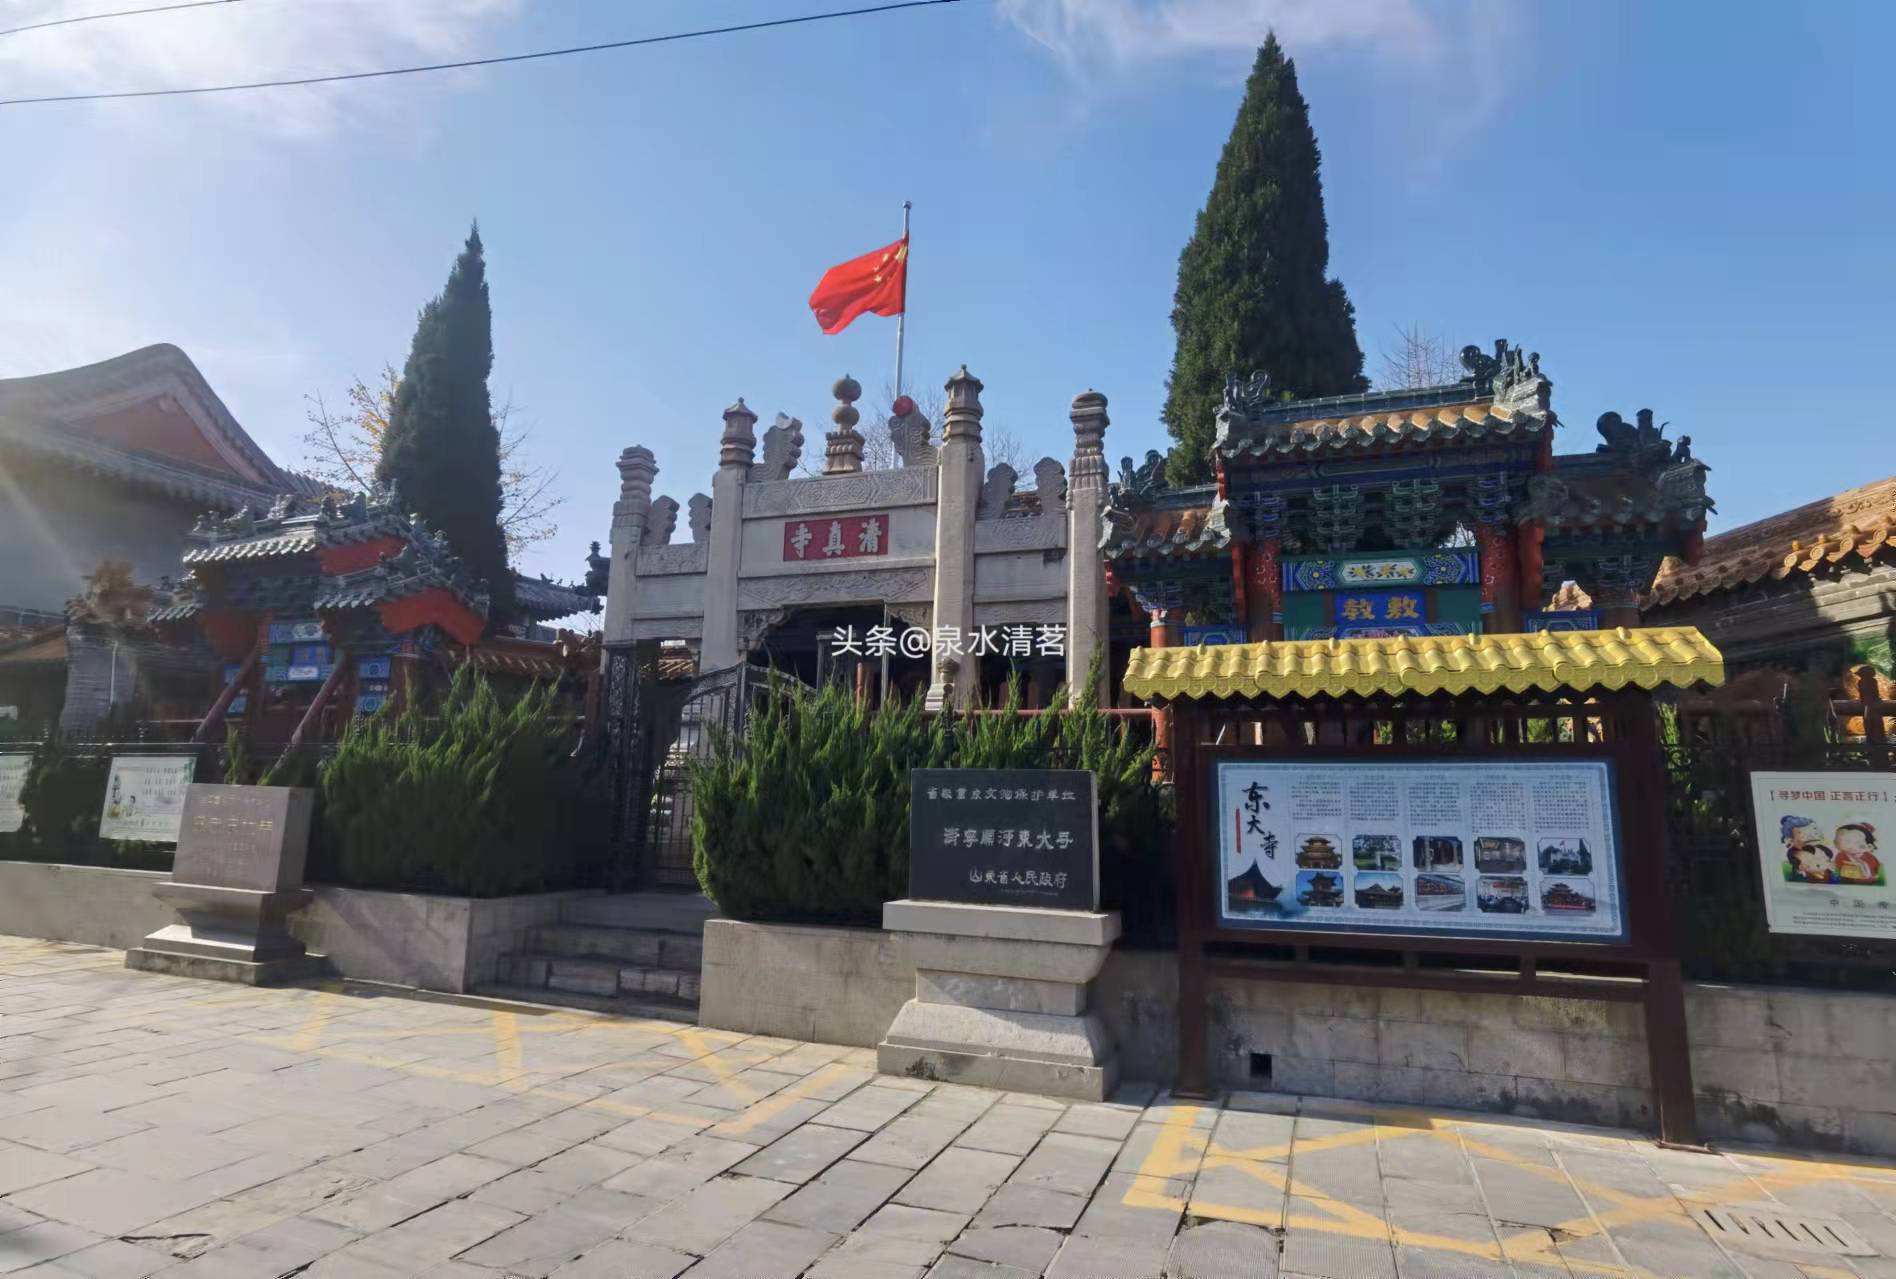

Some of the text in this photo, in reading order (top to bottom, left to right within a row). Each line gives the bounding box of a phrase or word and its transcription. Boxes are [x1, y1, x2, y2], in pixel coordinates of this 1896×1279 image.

[790, 517, 882, 559] 清真寺
[1241, 781, 1279, 860] 东大寺
